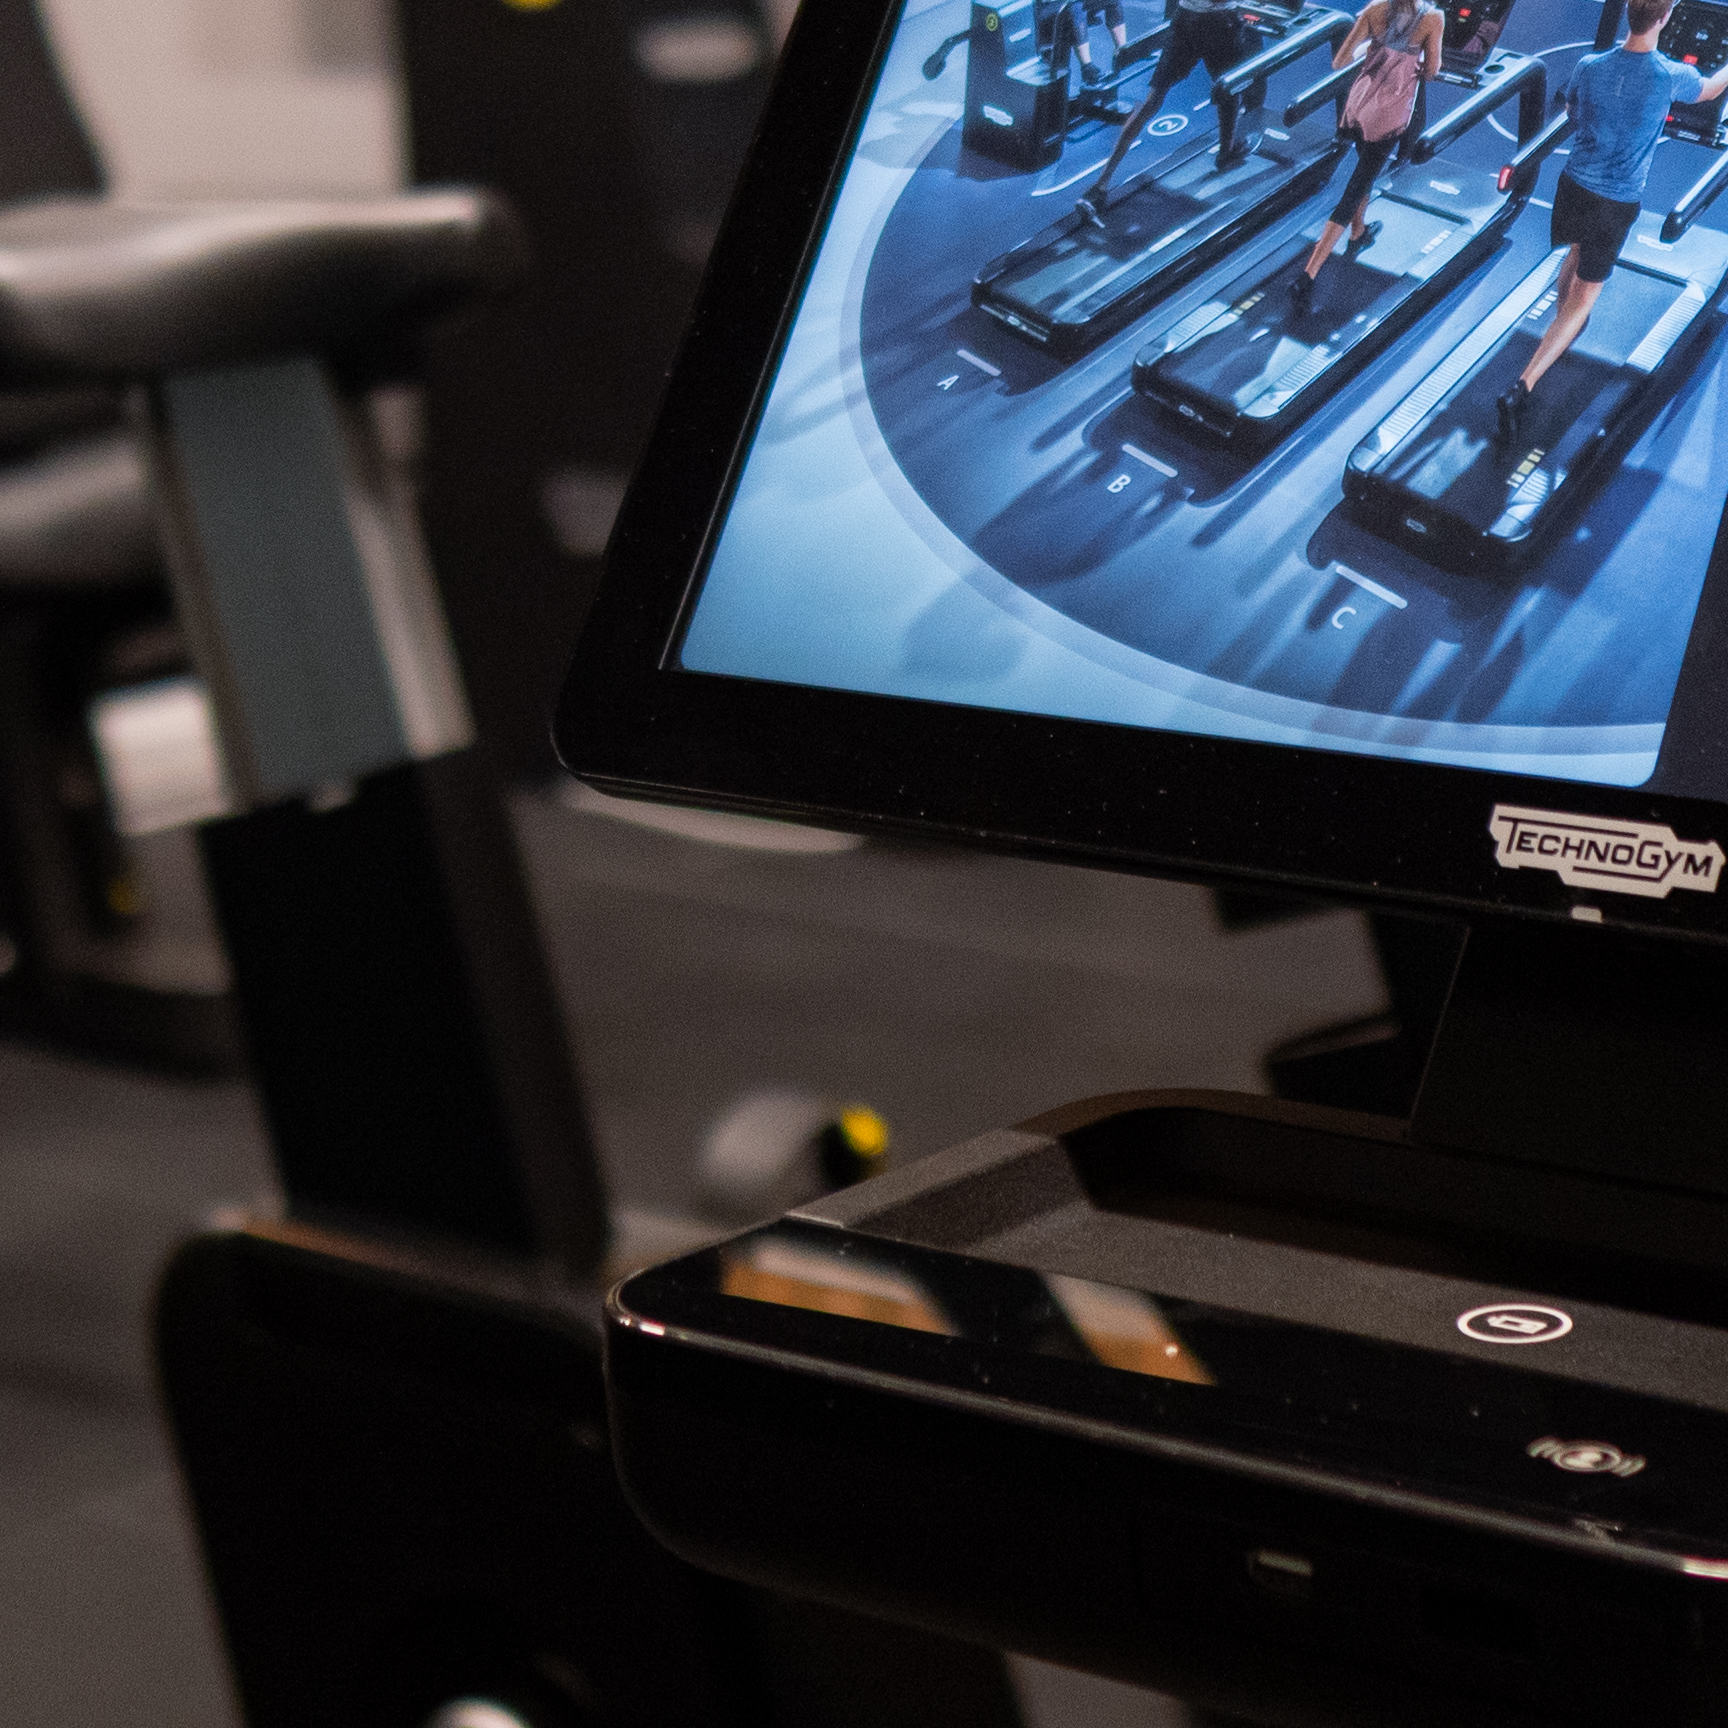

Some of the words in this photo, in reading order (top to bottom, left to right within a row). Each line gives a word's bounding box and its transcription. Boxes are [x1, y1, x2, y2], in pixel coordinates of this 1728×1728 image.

[936, 374, 960, 391] A
[1106, 473, 1132, 494] B
[1331, 606, 1357, 630] C
